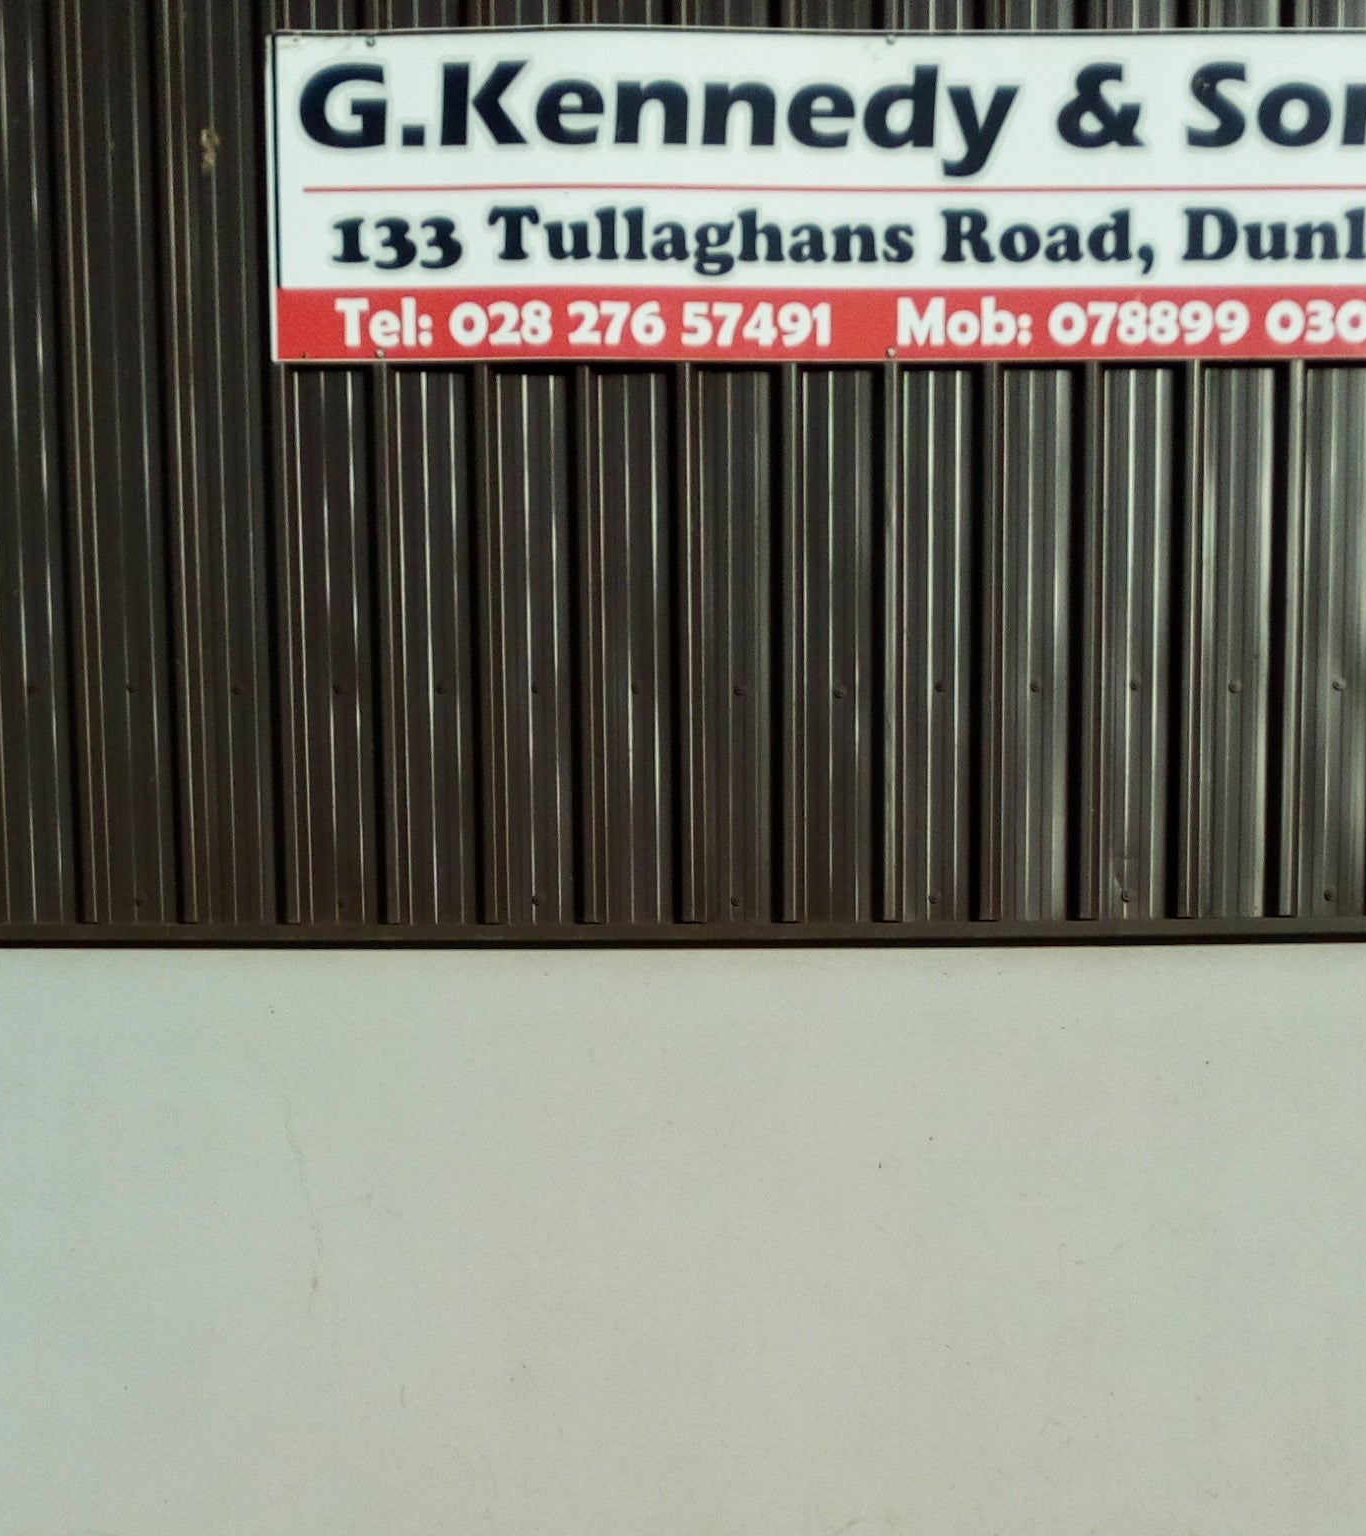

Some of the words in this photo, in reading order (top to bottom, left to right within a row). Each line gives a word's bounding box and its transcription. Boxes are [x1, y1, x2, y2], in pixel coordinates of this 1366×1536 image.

[299, 61, 1018, 178] G.Kennedy
[1057, 64, 1142, 149] &
[332, 217, 464, 270] 133
[488, 206, 914, 276] Tullaghans
[941, 210, 1154, 275] Road,
[335, 298, 433, 348] Tel:
[449, 301, 553, 347] 028
[567, 301, 667, 347] 276
[680, 301, 832, 348] 57491
[896, 296, 1033, 347] Mob:
[1048, 299, 1251, 346] 078899
